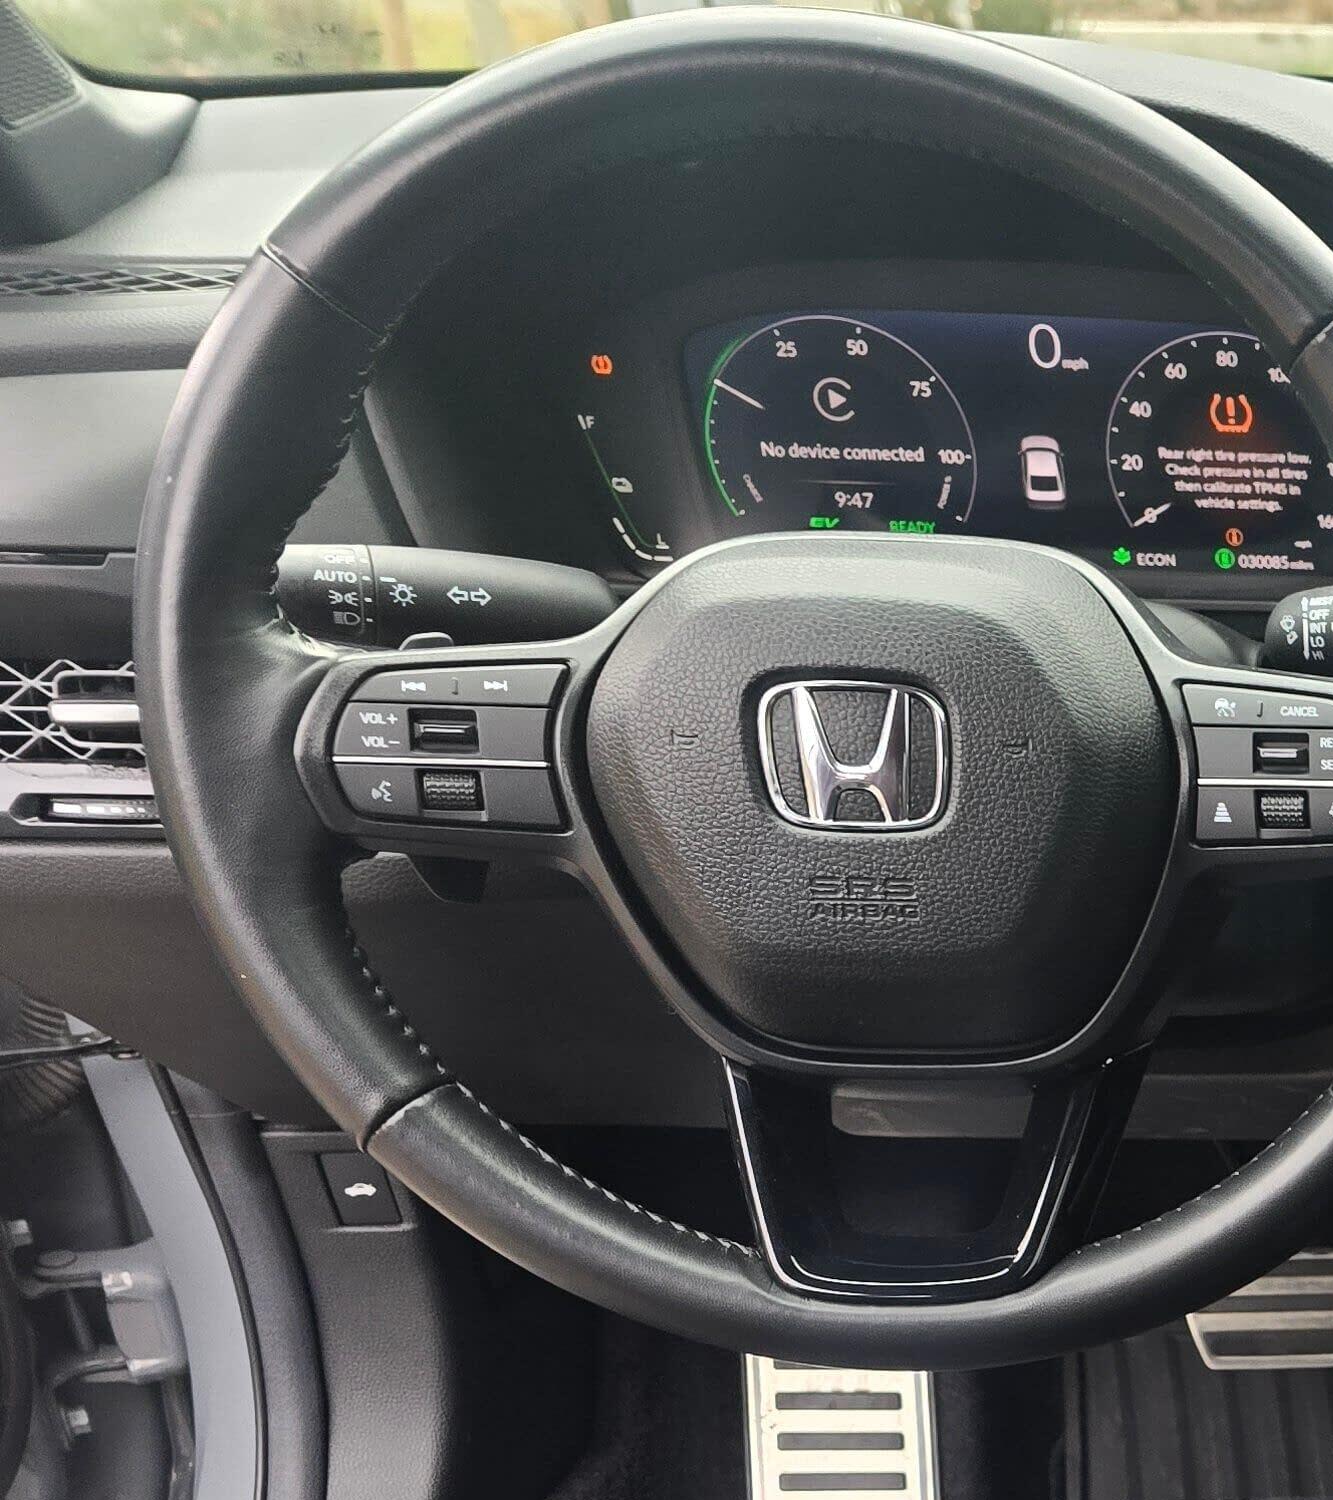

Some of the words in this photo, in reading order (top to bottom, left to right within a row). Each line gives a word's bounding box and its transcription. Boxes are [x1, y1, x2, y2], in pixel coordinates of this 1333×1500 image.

[775, 340, 798, 358] 25
[846, 338, 869, 356] 50
[1028, 323, 1062, 369] 0
[1215, 350, 1239, 368] 80
[1164, 362, 1188, 380] 60
[909, 380, 932, 398] 75
[1128, 400, 1152, 418] 40
[760, 440, 786, 458] No
[787, 442, 841, 460] device
[842, 446, 925, 463] connected
[937, 449, 964, 465] 100
[1120, 453, 1144, 471] 20
[834, 491, 874, 509] 9:47
[809, 516, 840, 529] EV
[888, 520, 937, 534] READY
[1135, 552, 1177, 567] ECON
[312, 569, 359, 584] AUTO
[1308, 609, 1330, 621] OFF
[1308, 621, 1328, 634] INT
[1309, 636, 1326, 648] LO
[1279, 705, 1319, 718] CANCEL
[809, 876, 918, 900] SRS
